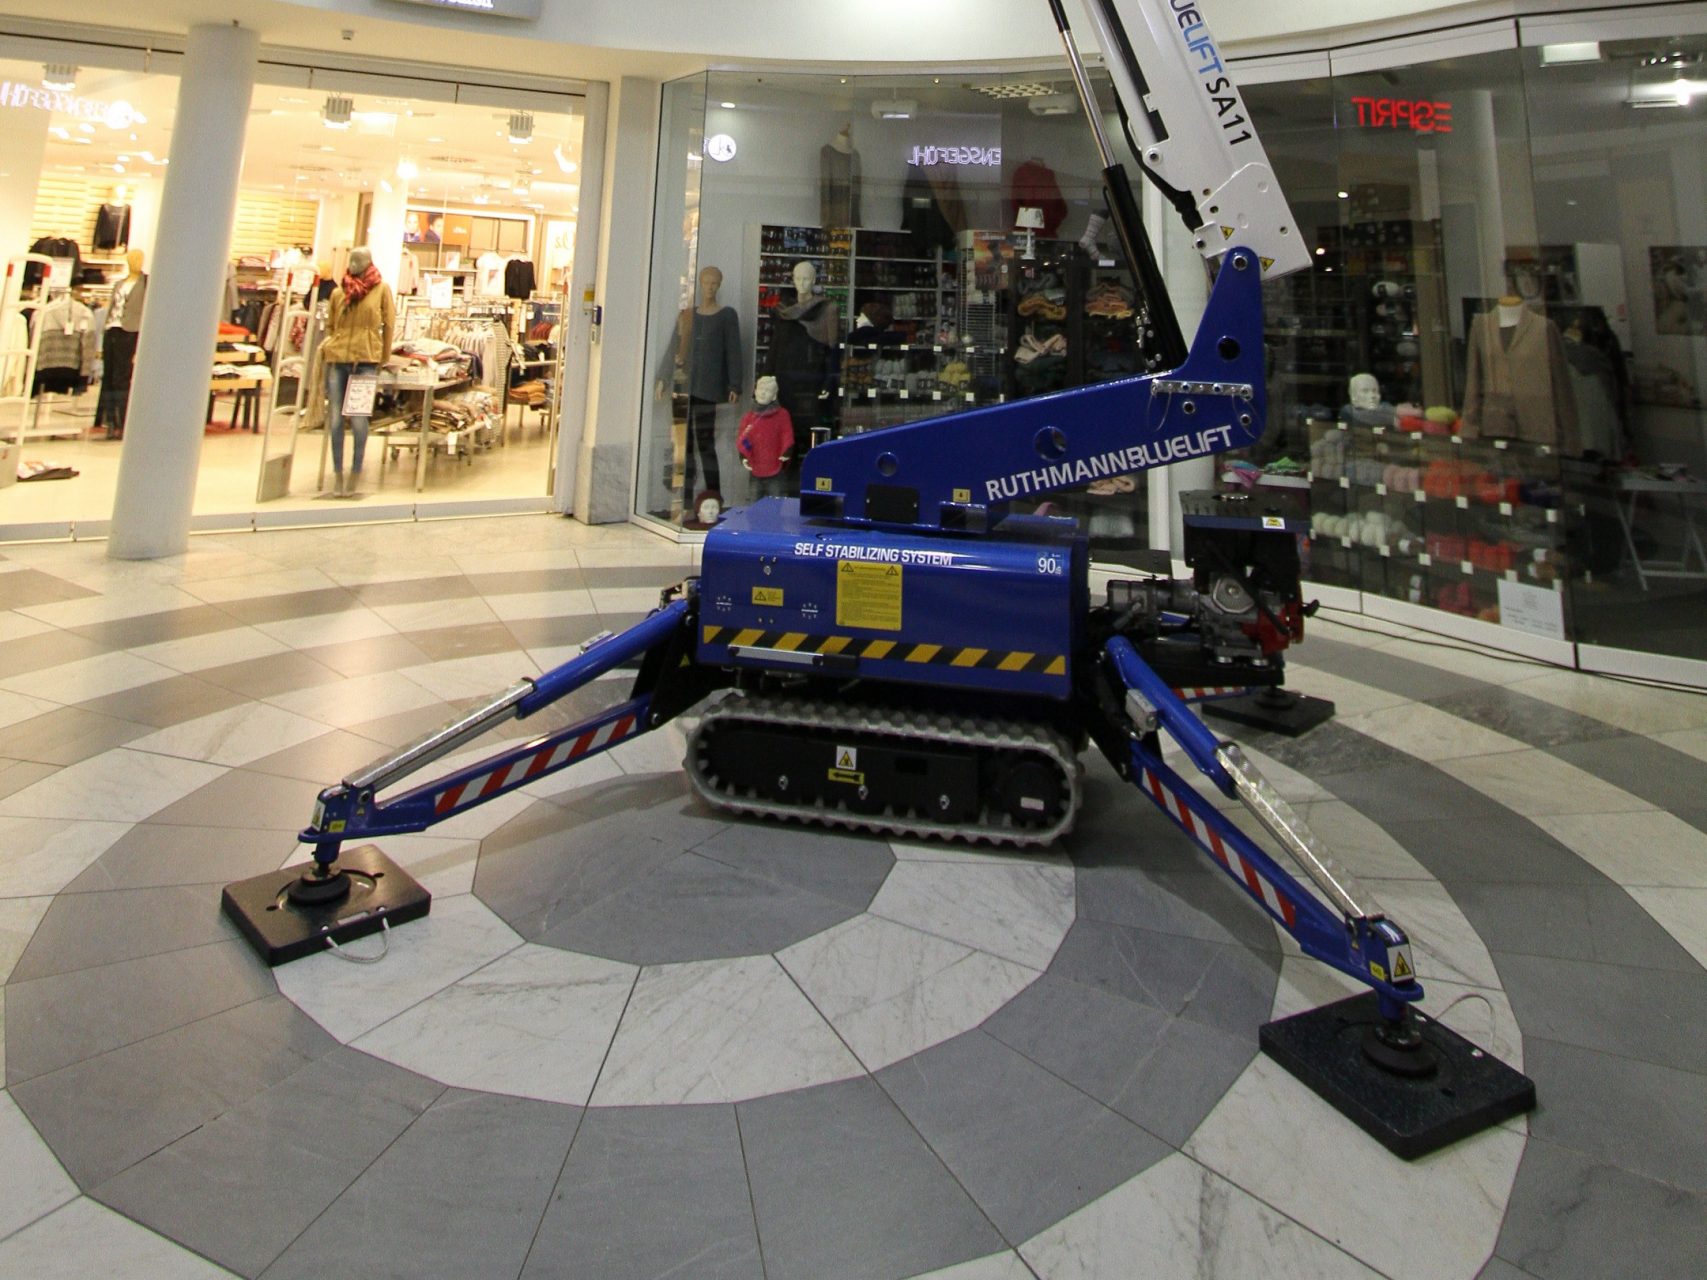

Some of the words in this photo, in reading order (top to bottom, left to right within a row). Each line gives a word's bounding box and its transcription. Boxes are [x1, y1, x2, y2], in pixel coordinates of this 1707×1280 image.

[1205, 76, 1252, 145] SA11
[794, 542, 824, 557] SELF
[825, 545, 900, 562] STABILIZING
[901, 549, 952, 566] SYSTEM
[1038, 557, 1056, 574] 90
